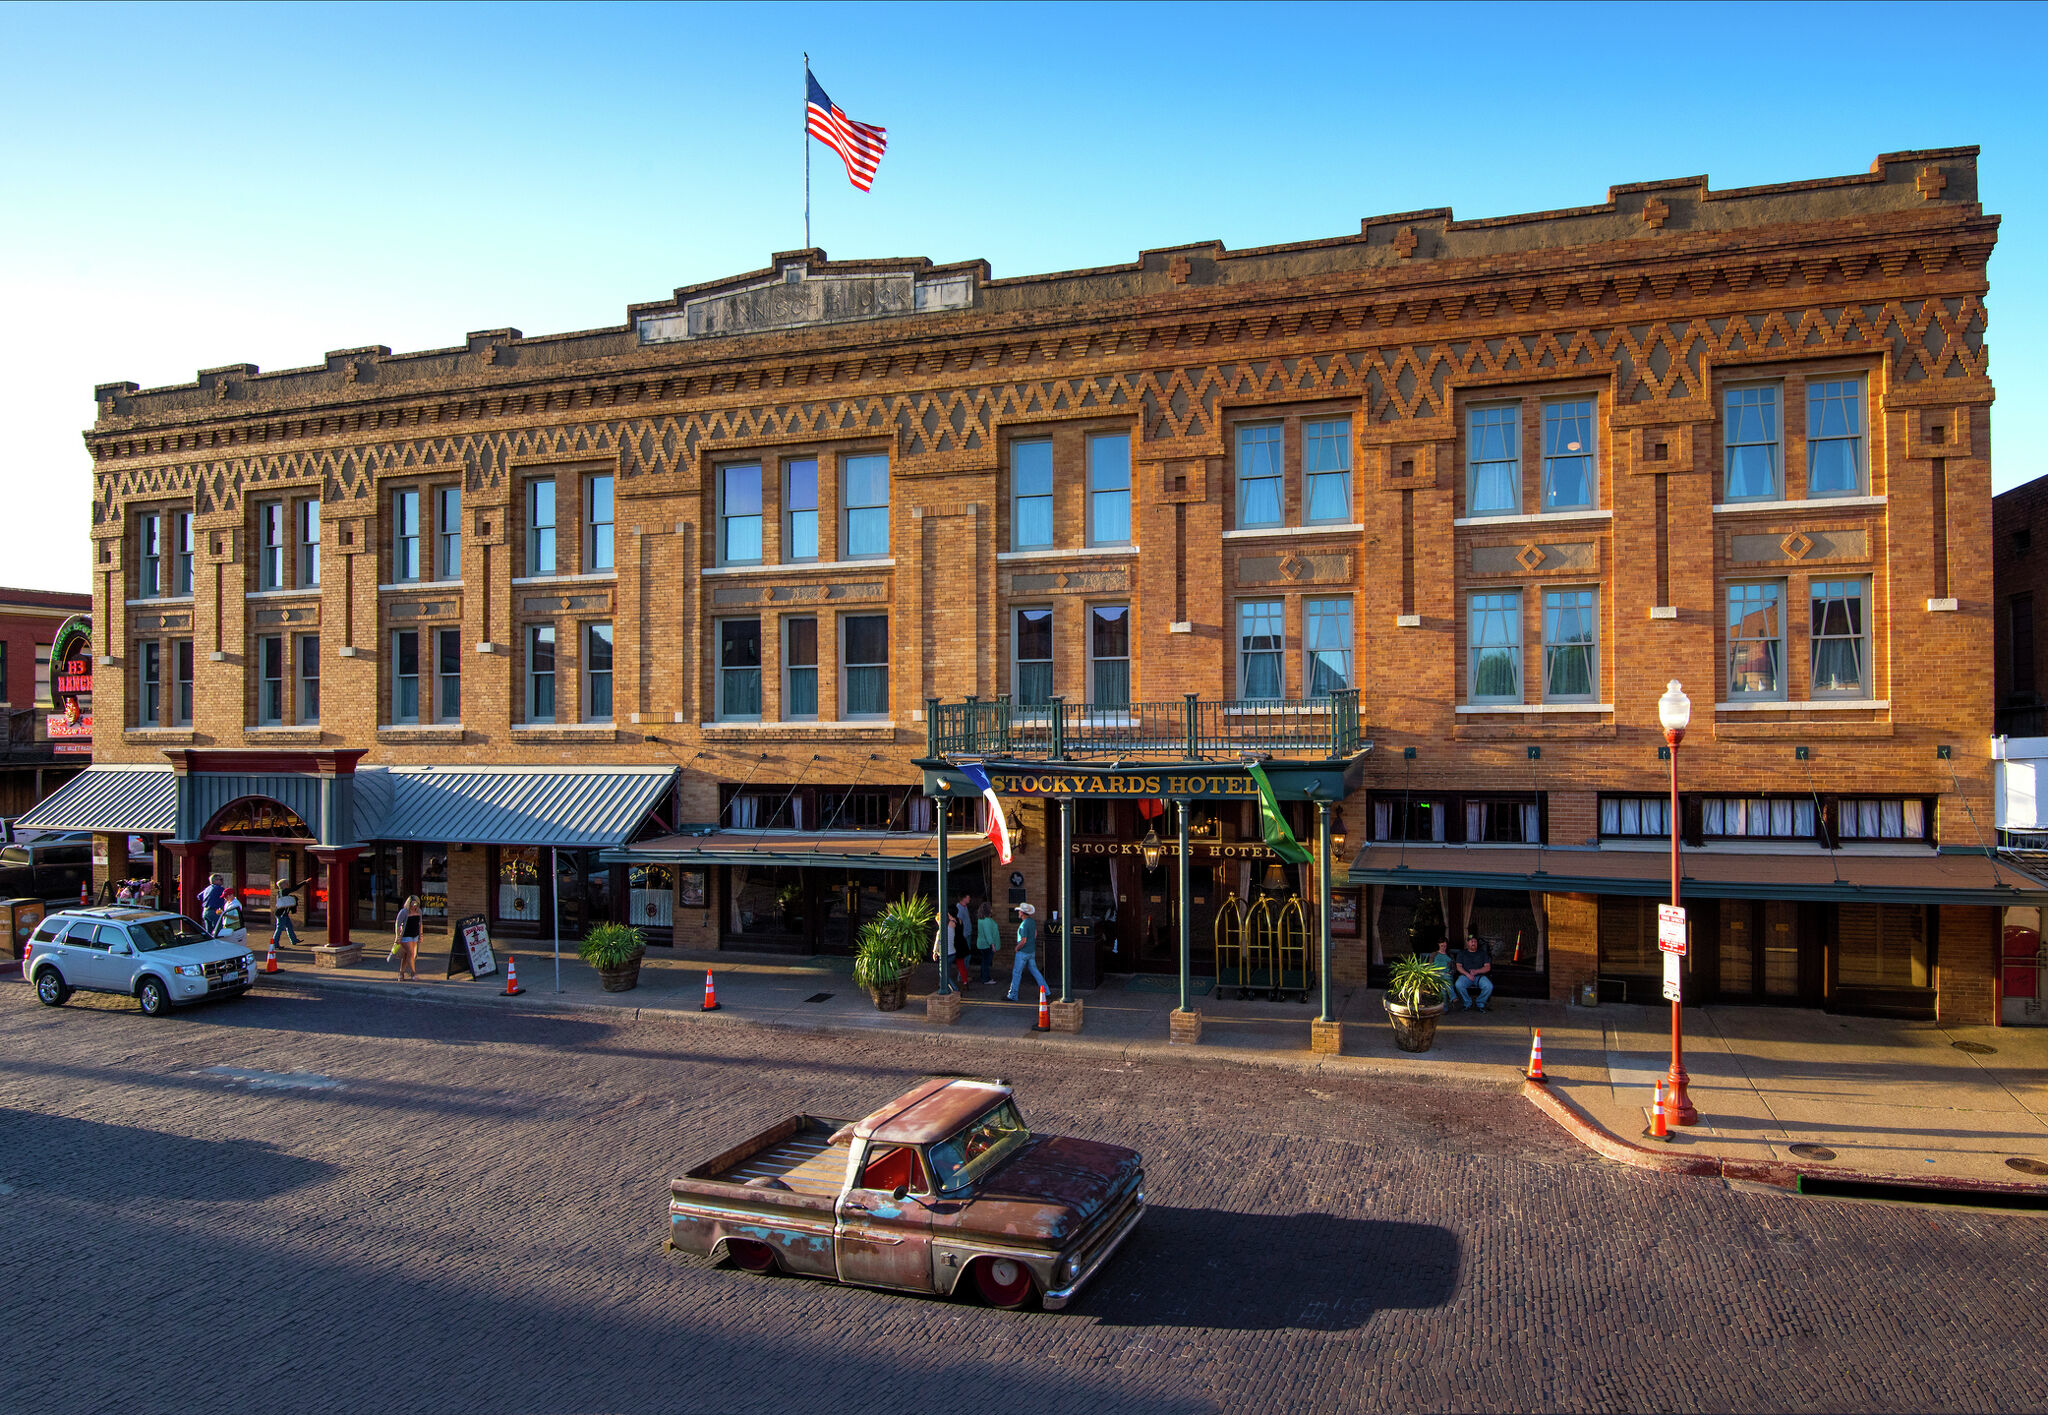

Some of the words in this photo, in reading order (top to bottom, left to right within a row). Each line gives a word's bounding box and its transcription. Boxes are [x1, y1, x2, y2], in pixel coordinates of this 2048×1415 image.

[692, 296, 819, 330] THANNISCH
[826, 287, 909, 315] BLOCK
[68, 661, 85, 675] H3
[991, 775, 1160, 794] STOCKYARDS
[1168, 776, 1259, 794] HOTEL
[1071, 843, 1194, 856] STOCKYRDS
[1209, 846, 1276, 858] HOTEL
[1048, 924, 1090, 935] VAET
